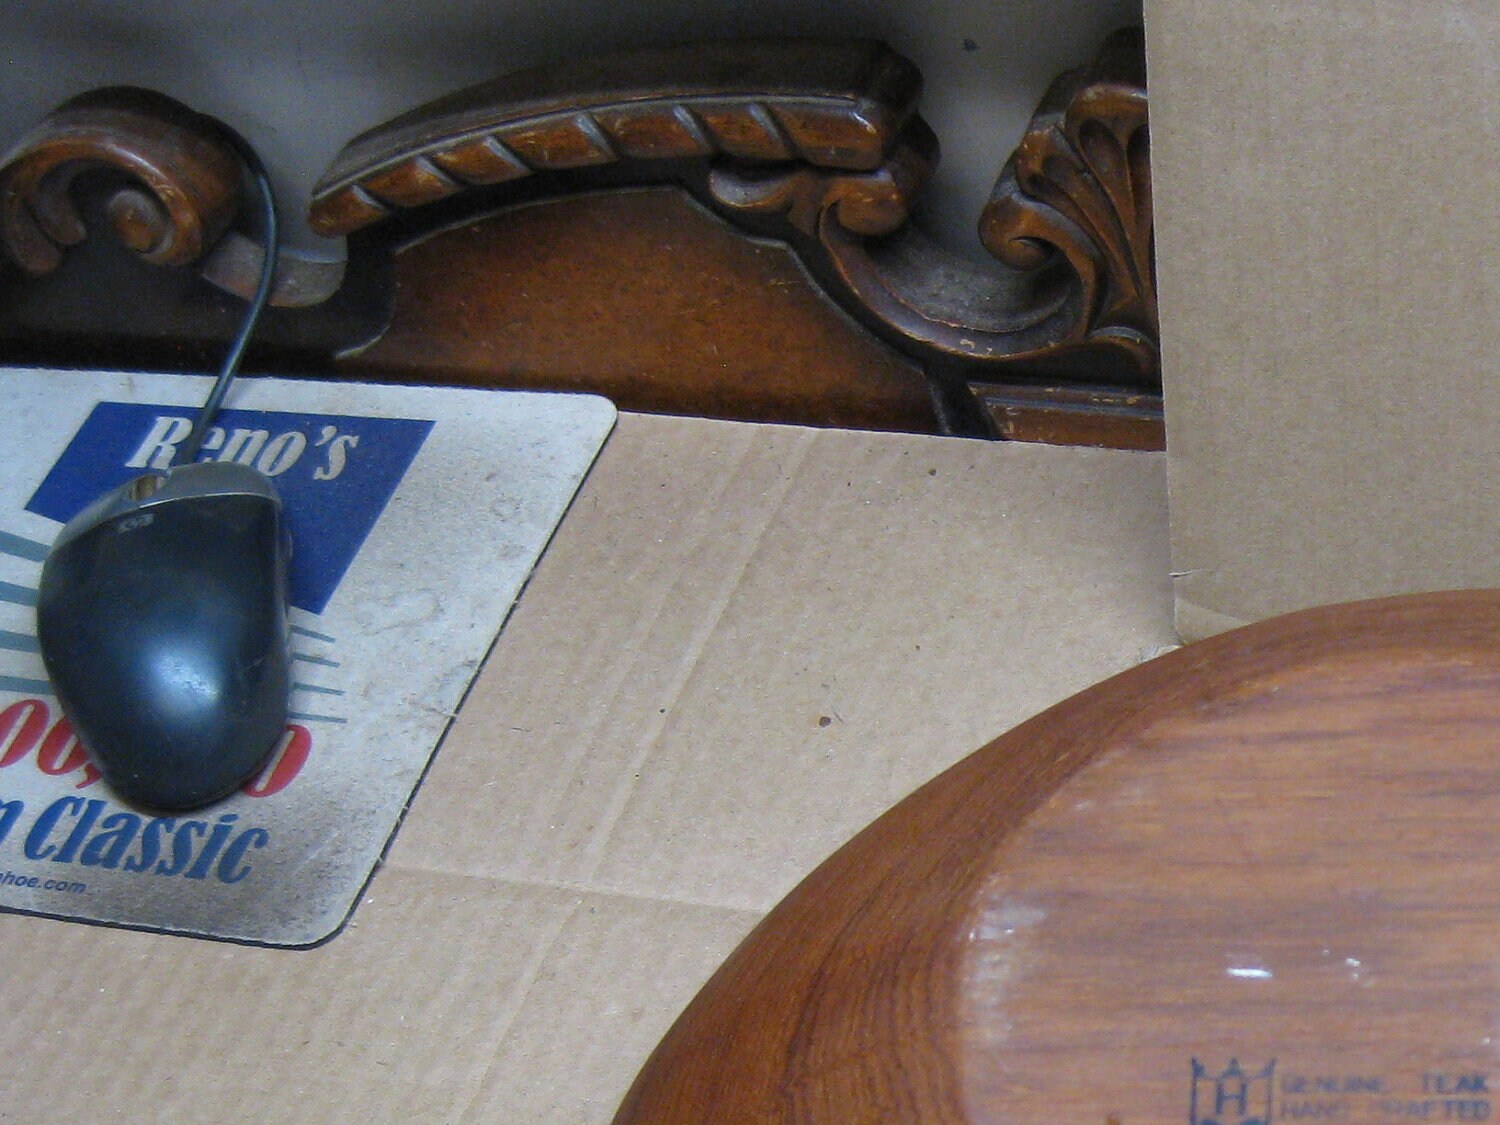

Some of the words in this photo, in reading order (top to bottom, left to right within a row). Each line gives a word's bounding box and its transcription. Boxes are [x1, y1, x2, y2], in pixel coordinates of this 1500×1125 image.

[124, 415, 360, 481] Reno's
[23, 795, 270, 884] Classic
[1419, 1072, 1489, 1093] TEAK
